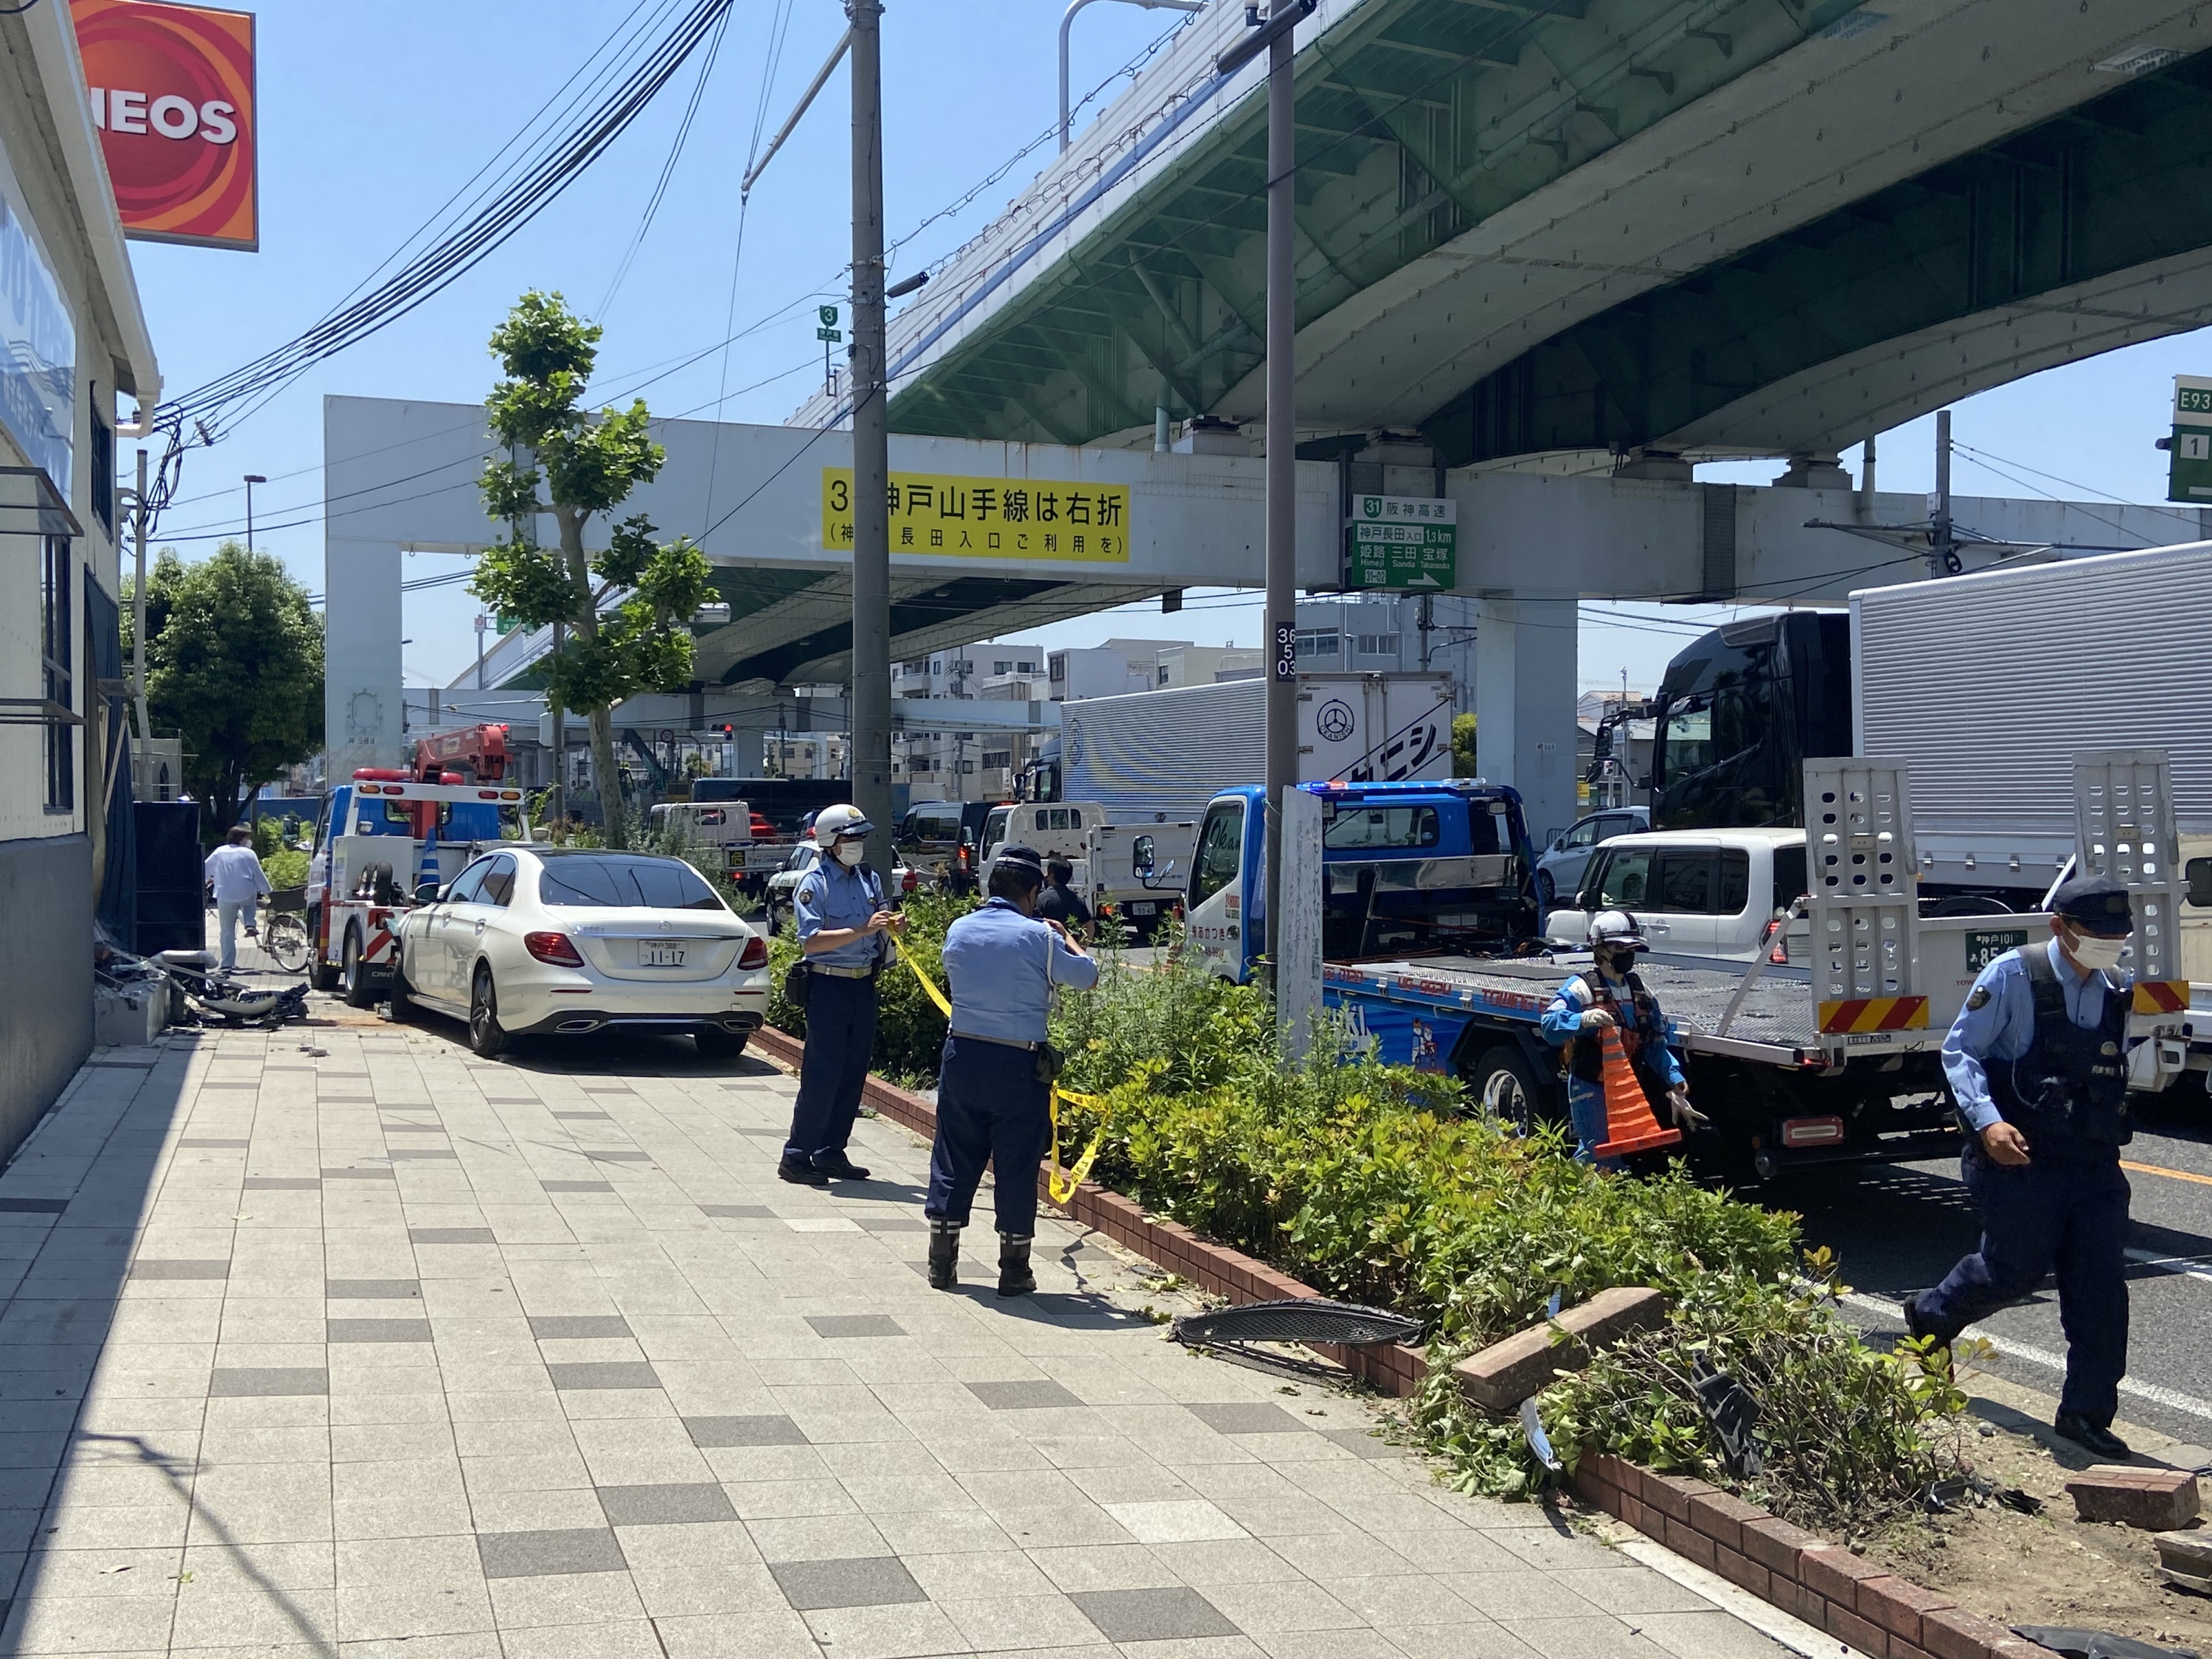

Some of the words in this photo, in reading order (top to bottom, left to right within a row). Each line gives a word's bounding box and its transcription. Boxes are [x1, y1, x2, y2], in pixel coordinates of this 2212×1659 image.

[824, 308, 833, 322] 3
[2181, 392, 2211, 409] E93
[2191, 437, 2198, 456] 1
[1366, 500, 1380, 513] 31
[1387, 502, 1446, 518] 阪神高速
[830, 522, 1121, 555] (神長田入口ご利用を)
[1360, 545, 1385, 558] 姫路
[1391, 546, 1416, 560] 三田
[1423, 548, 1448, 561] 宝塚
[1360, 559, 1385, 568] Himeji
[1392, 560, 1415, 568] Sanda
[1366, 571, 1385, 582] 31-02
[1277, 628, 1296, 644] 36
[1284, 644, 1293, 659] 5
[1277, 660, 1296, 675] 03
[1319, 723, 1352, 740] OKANISHI
[730, 852, 745, 866] 危
[651, 950, 685, 964] 11-17
